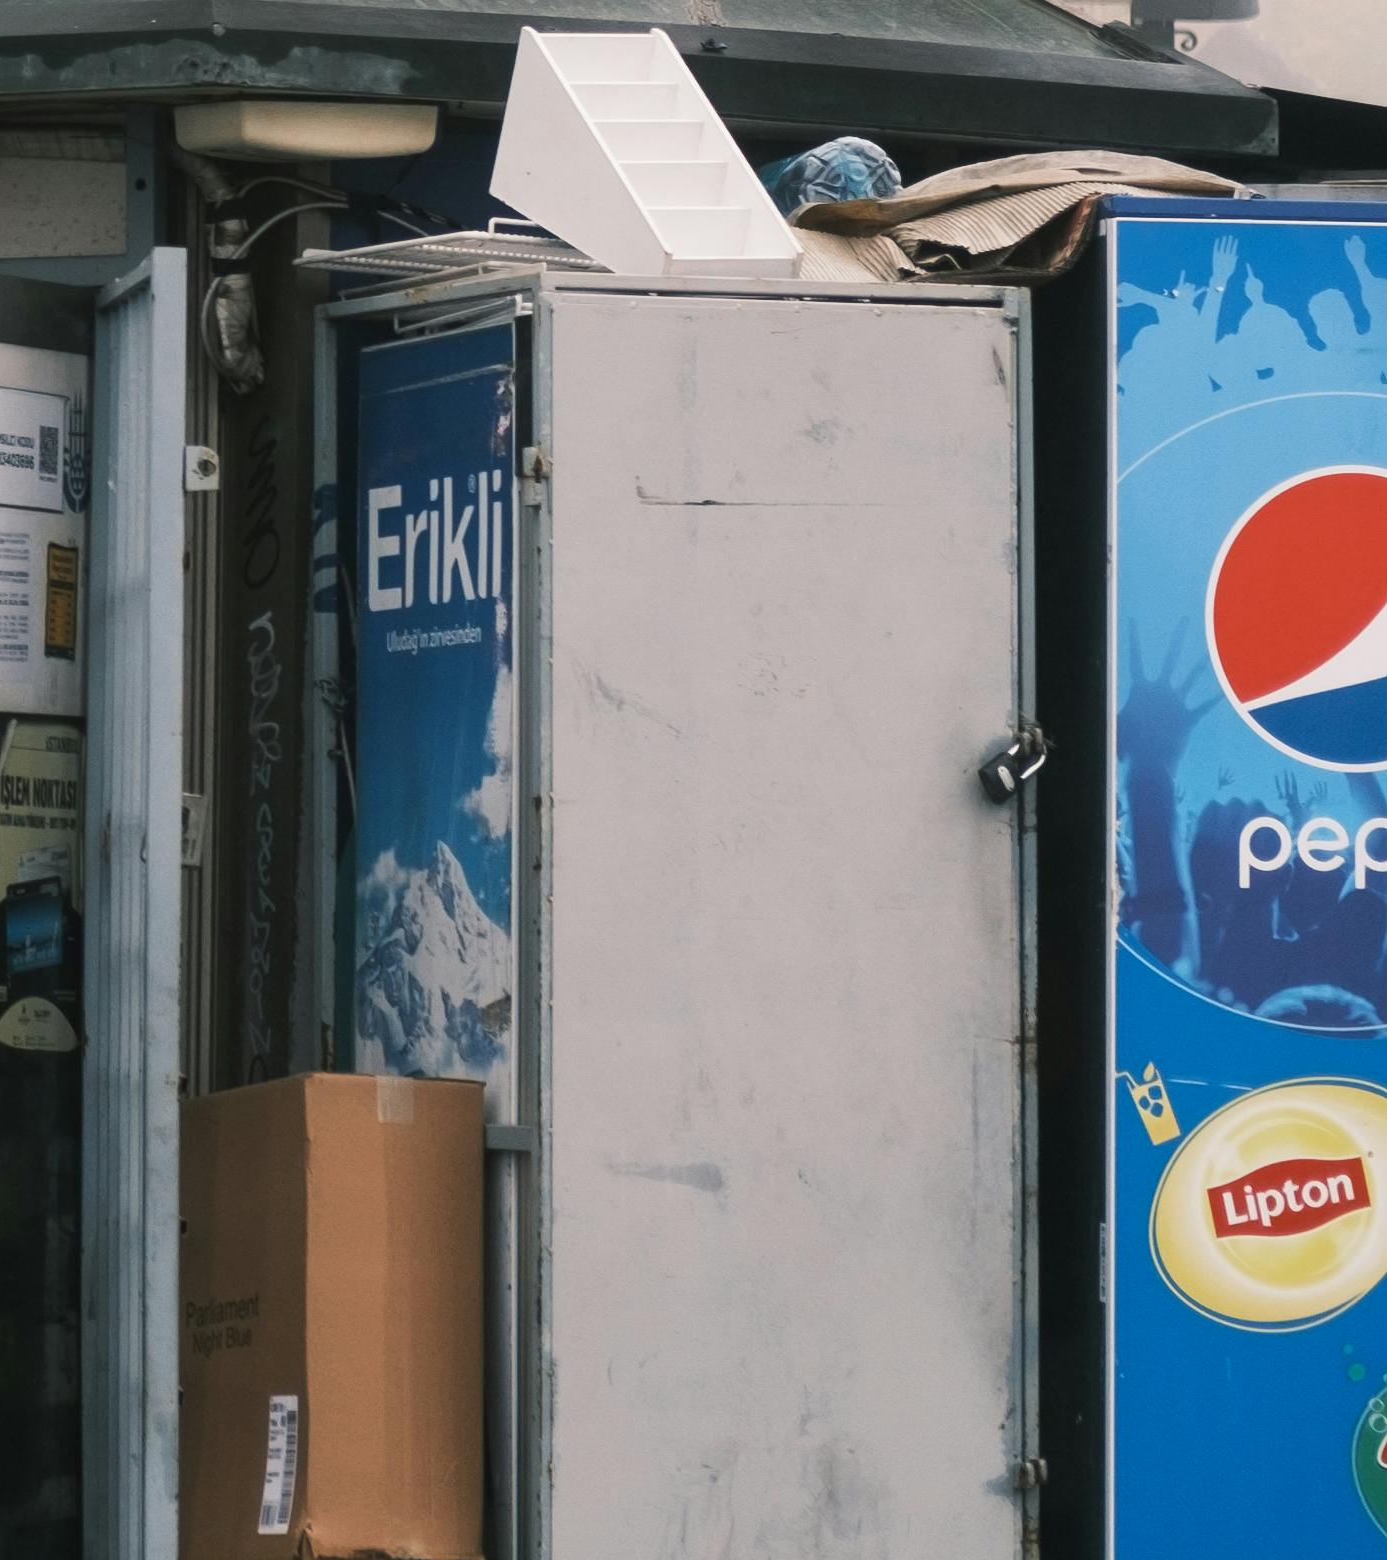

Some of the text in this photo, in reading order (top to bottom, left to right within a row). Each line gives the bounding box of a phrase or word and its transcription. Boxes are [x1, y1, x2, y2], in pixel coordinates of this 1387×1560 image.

[368, 469, 503, 612] Erikli
[0, 773, 77, 811] İŞLEM NOKTASI
[1239, 816, 1387, 889] pep
[1222, 1174, 1355, 1227] Lipton
[186, 1294, 260, 1328] Parliament
[192, 1326, 253, 1359] Night Blue
